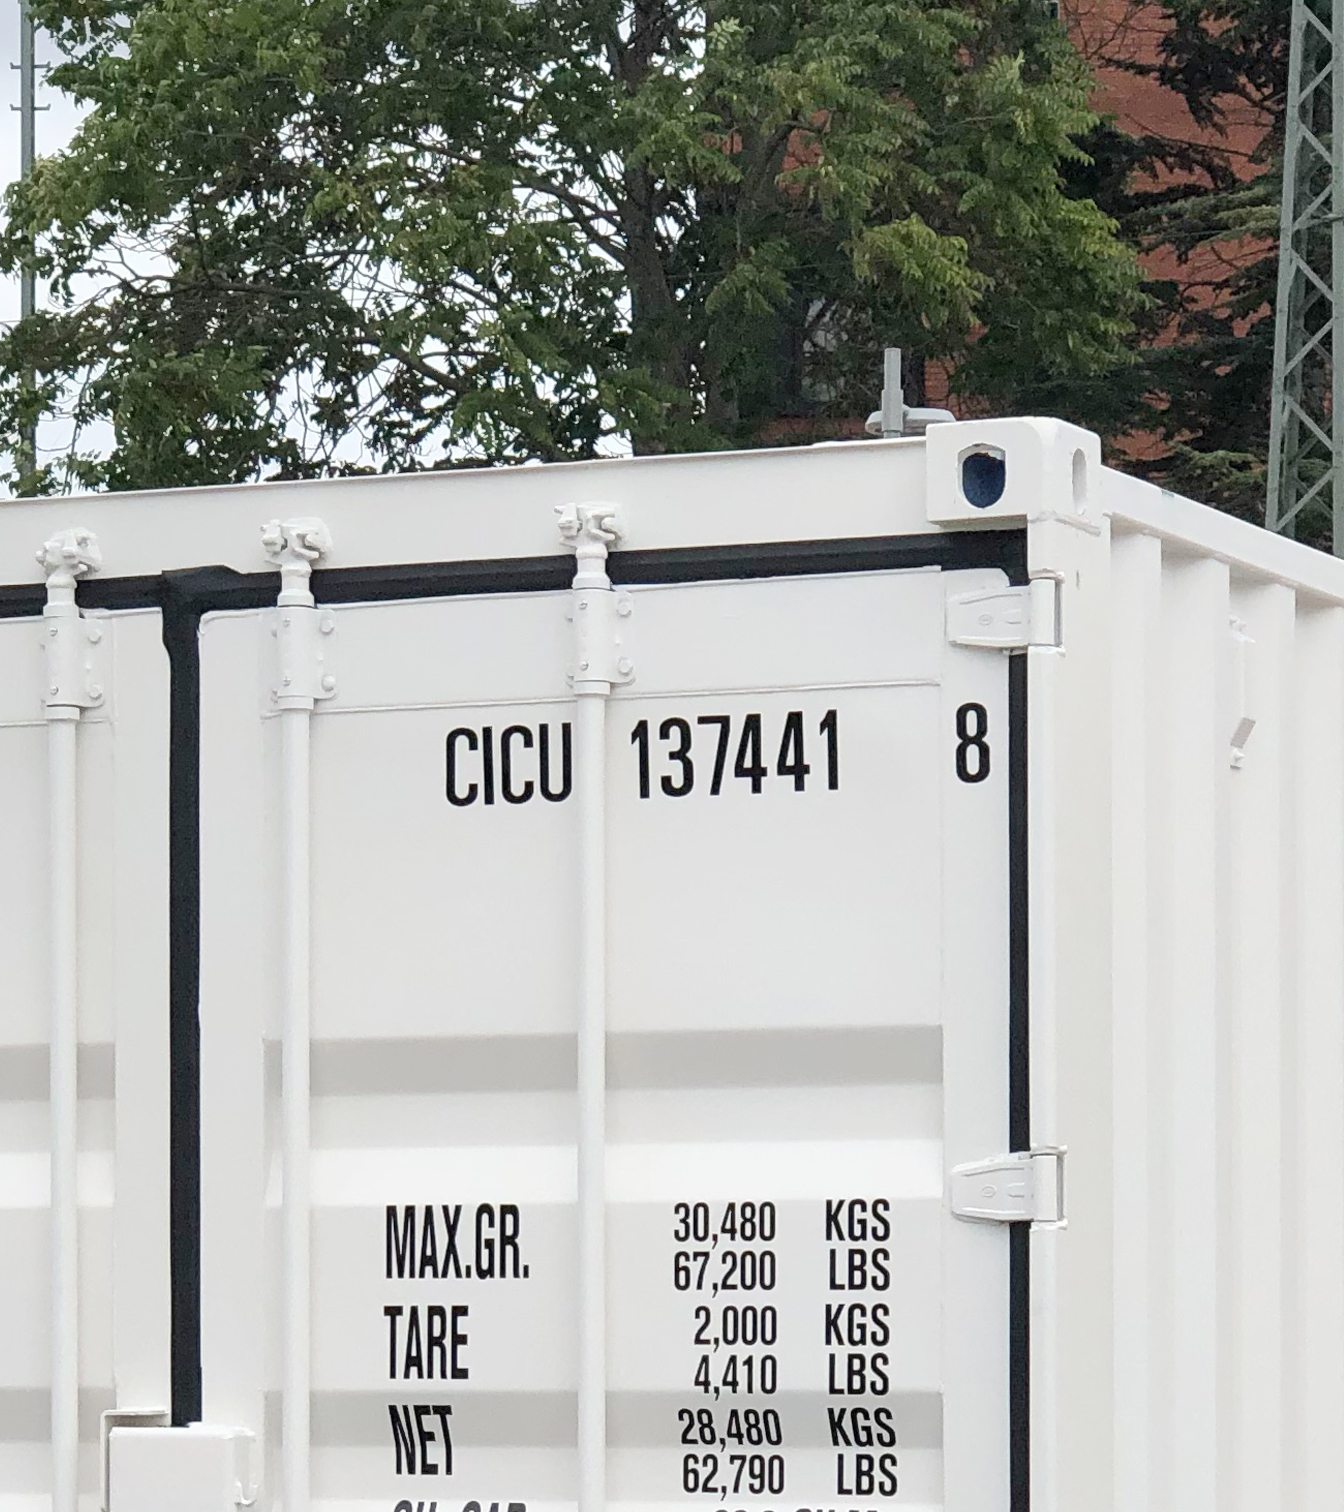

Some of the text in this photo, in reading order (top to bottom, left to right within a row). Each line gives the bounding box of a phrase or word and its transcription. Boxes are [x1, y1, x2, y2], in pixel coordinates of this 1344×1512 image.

[446, 702, 991, 807] CICU 137441 8
[385, 1198, 891, 1280] MAX.GR. 30,480 KGS
[673, 1247, 890, 1297] 67,200 LBS
[383, 1303, 890, 1380] TARE 2,000 KGS
[693, 1352, 890, 1401] 4,410 LBS
[388, 1404, 897, 1476] NET 28,480 KGS
[682, 1453, 898, 1501] 62,790 LBS
